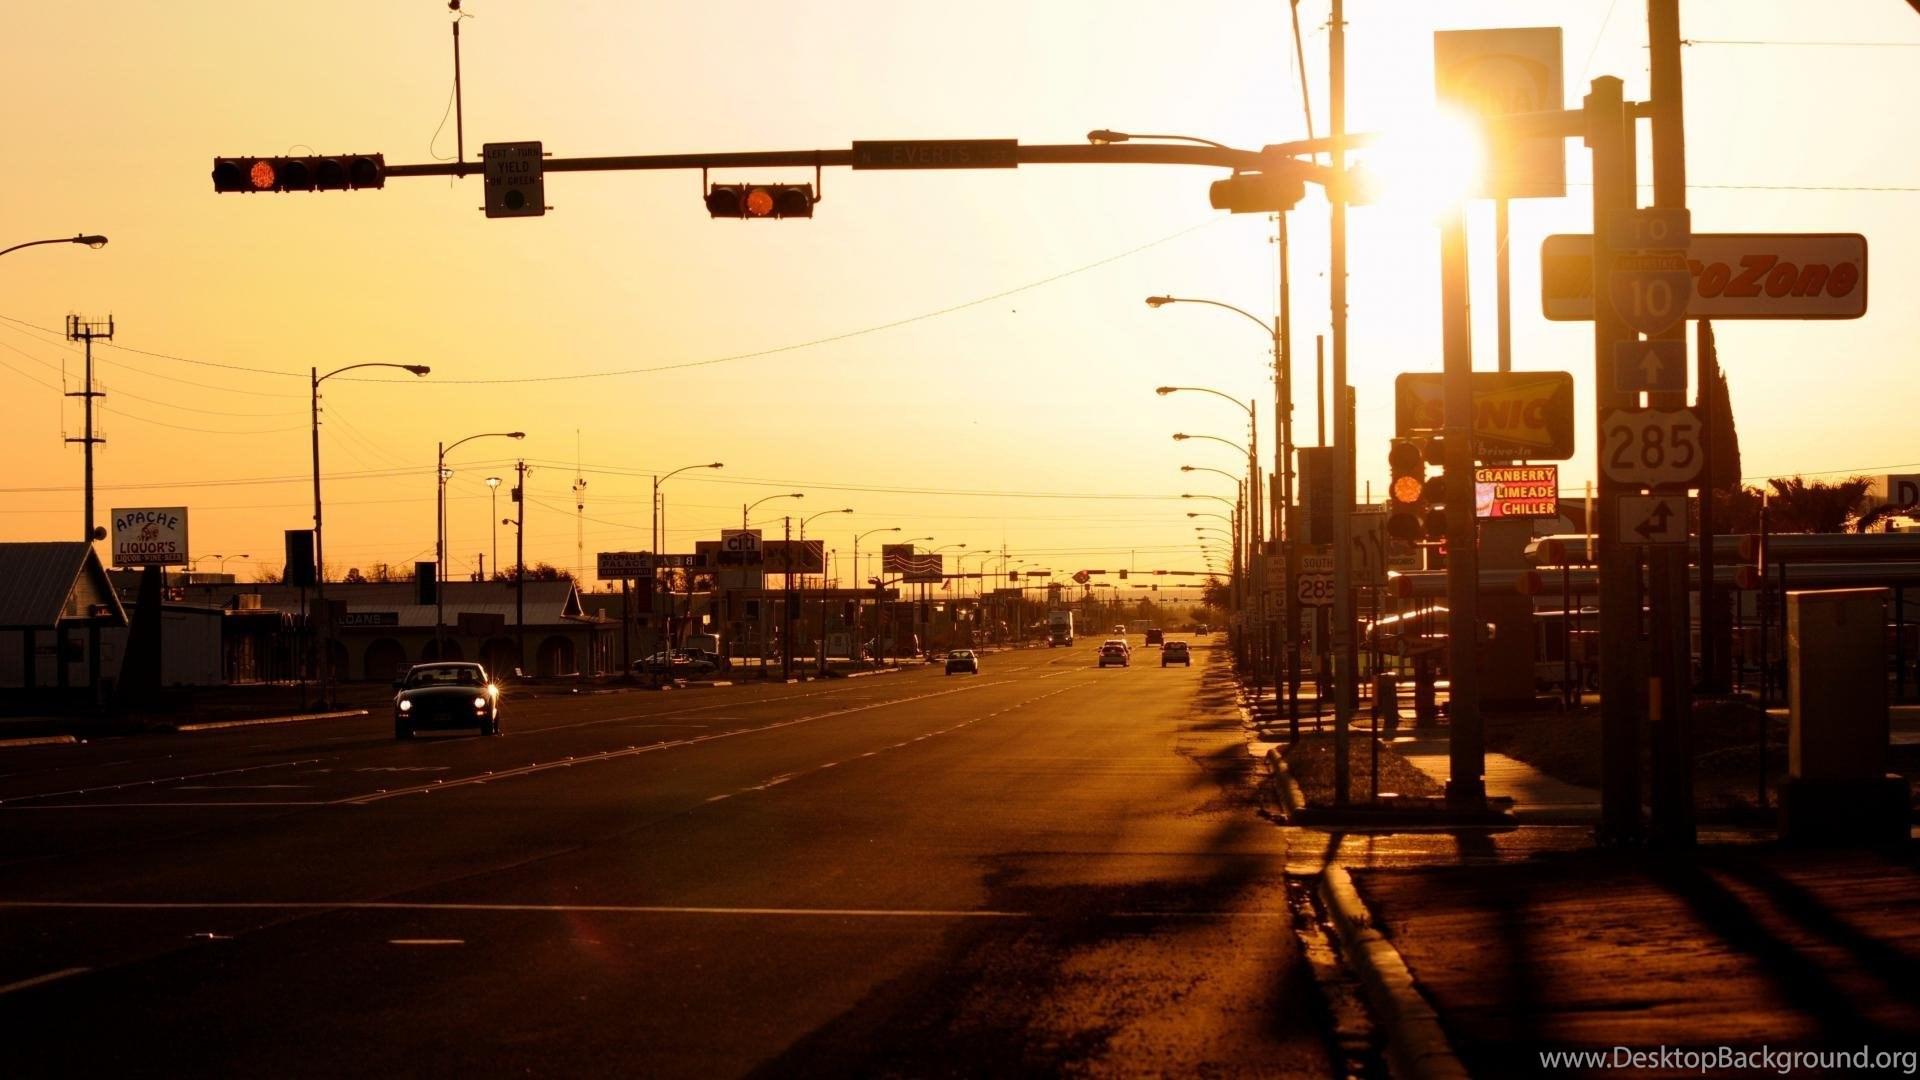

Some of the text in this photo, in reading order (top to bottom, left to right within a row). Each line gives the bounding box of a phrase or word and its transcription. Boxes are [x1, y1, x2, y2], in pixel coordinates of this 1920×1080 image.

[893, 145, 970, 162] EVERTS
[497, 161, 529, 173] YIELD
[490, 175, 535, 186] ON GREEN
[1629, 217, 1668, 240] TO
[1631, 279, 1672, 317] 10
[1424, 399, 1553, 431] SNIC
[1610, 424, 1694, 468] 285
[1476, 469, 1555, 482] CRANBERRY
[1496, 485, 1555, 499] LIMEADE
[1502, 502, 1555, 515] CHILLER
[116, 511, 178, 532] APACHE
[120, 541, 176, 553] LIQUOR'S
[602, 560, 648, 568] PALACE
[1303, 558, 1333, 568] SOUTH
[1301, 580, 1335, 598] 285
[339, 614, 381, 625] LOANS
